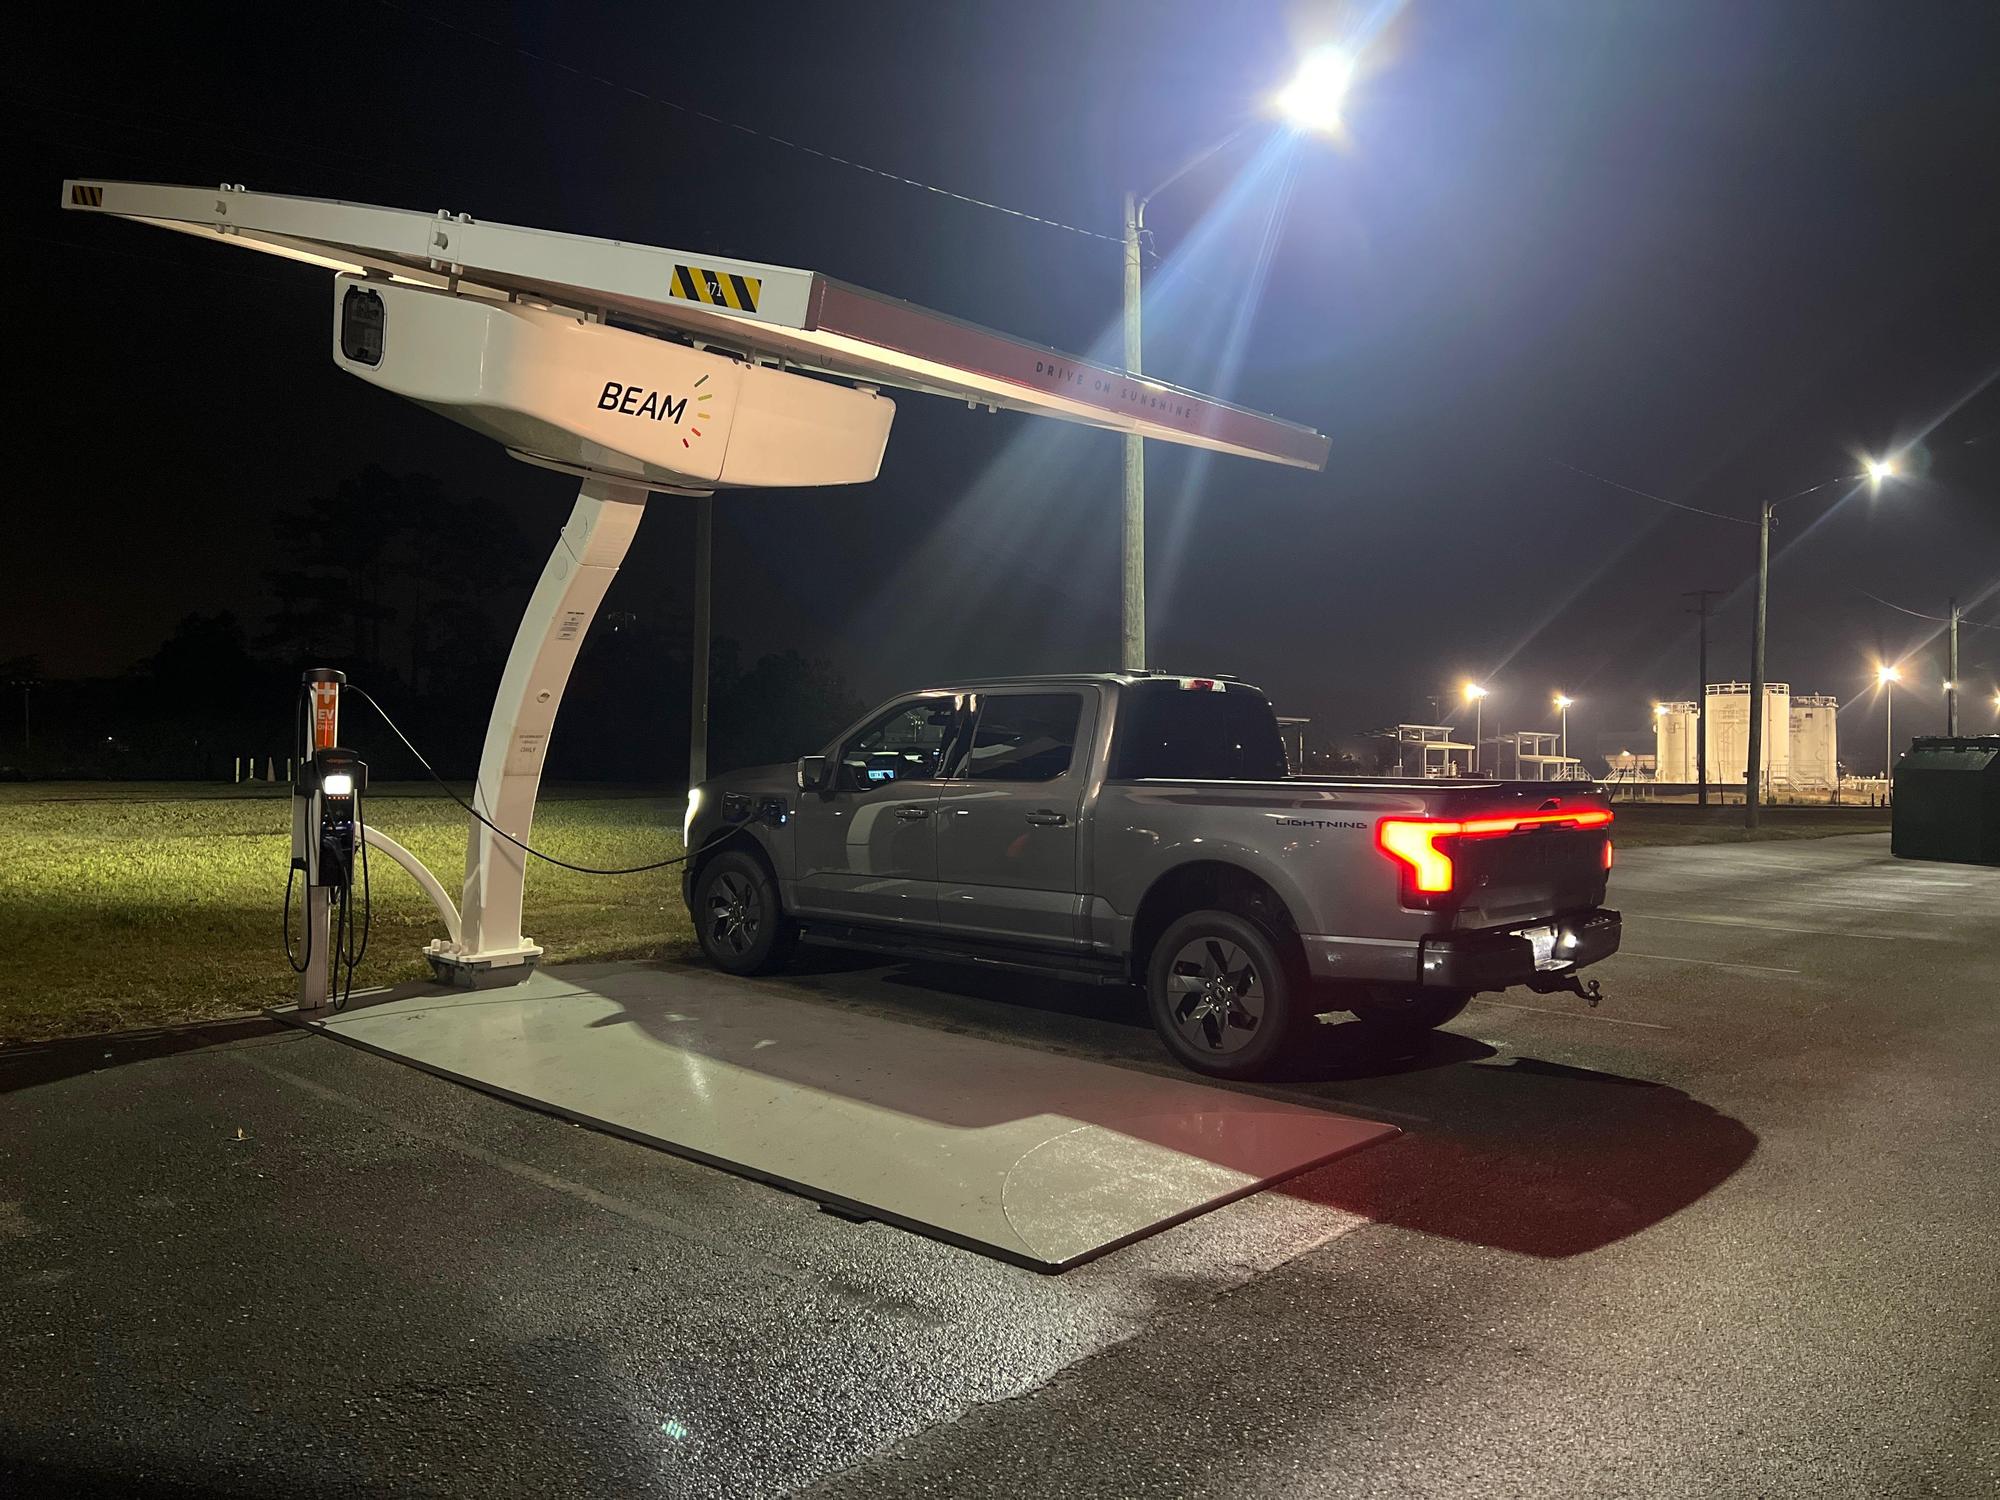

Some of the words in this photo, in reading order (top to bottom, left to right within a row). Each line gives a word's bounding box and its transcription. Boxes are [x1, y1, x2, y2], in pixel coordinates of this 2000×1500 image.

[704, 281, 722, 297] 471
[1036, 361, 1084, 385] DRIVE
[1094, 379, 1111, 393] ON
[1121, 388, 1192, 418] SUNSHINE
[597, 381, 688, 424] BEAM
[318, 708, 335, 720] EV
[317, 723, 334, 731] ONLY
[1276, 819, 1368, 829] LIGHTNING
